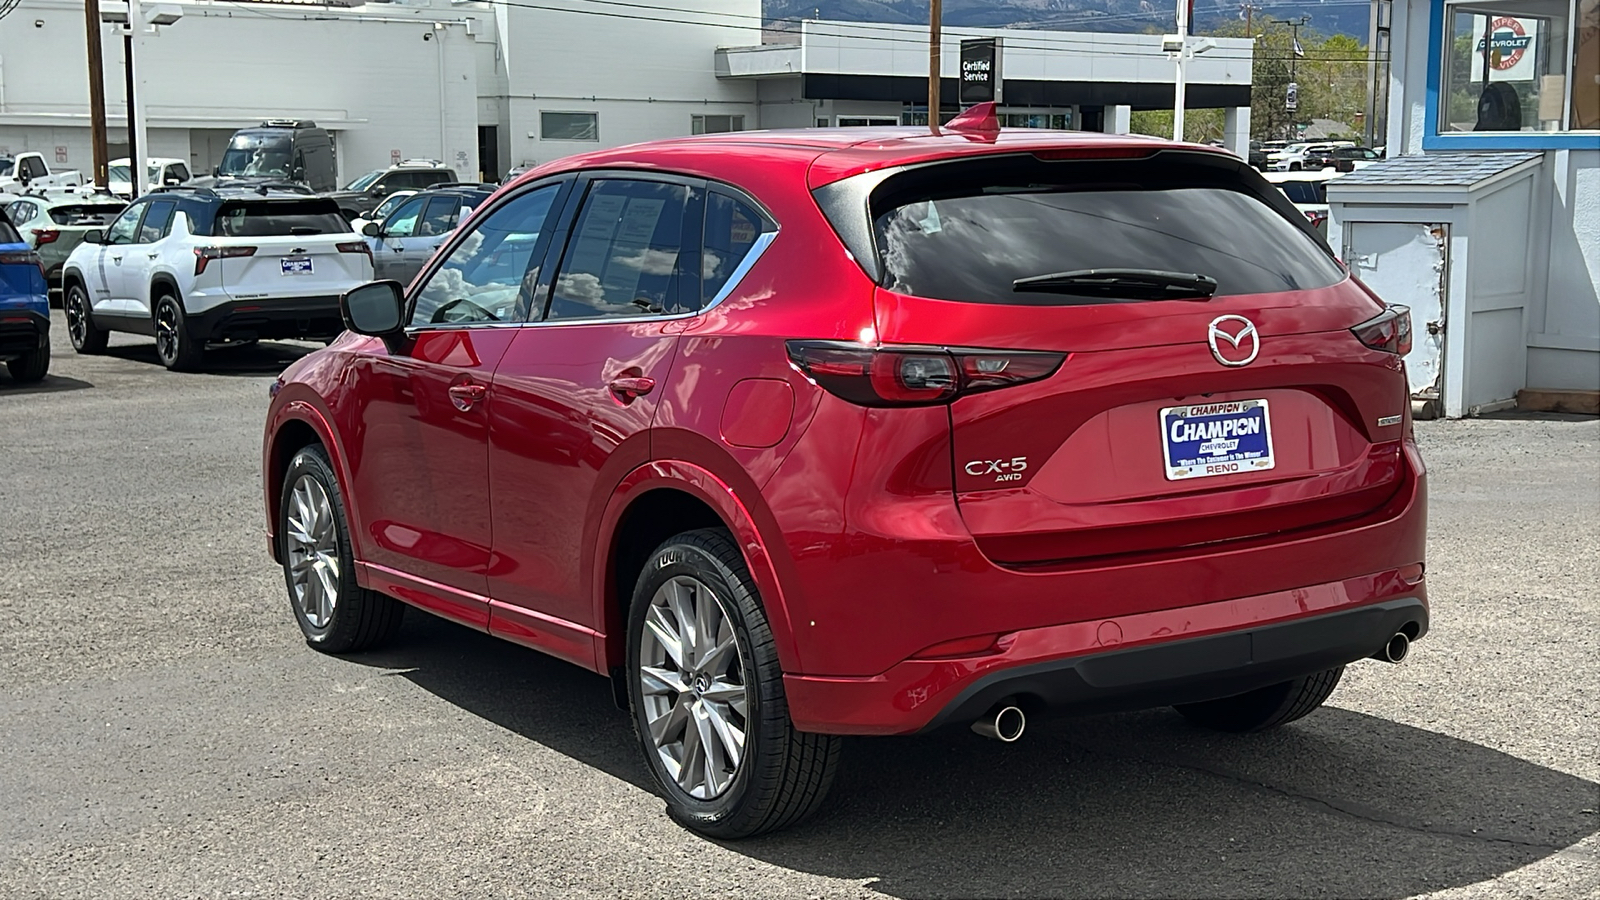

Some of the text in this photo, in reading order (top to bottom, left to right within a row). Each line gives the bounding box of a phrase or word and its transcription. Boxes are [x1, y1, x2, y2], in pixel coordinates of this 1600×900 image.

[963, 60, 990, 70] Certified
[964, 71, 988, 80] Service
[1190, 403, 1239, 416] CHAMPION
[1171, 417, 1260, 443] CHAMPION
[1201, 441, 1236, 451] CHEVROLET
[965, 456, 1027, 475] CX-5
[1206, 463, 1239, 474] RENO
[995, 473, 1022, 482] AWD
